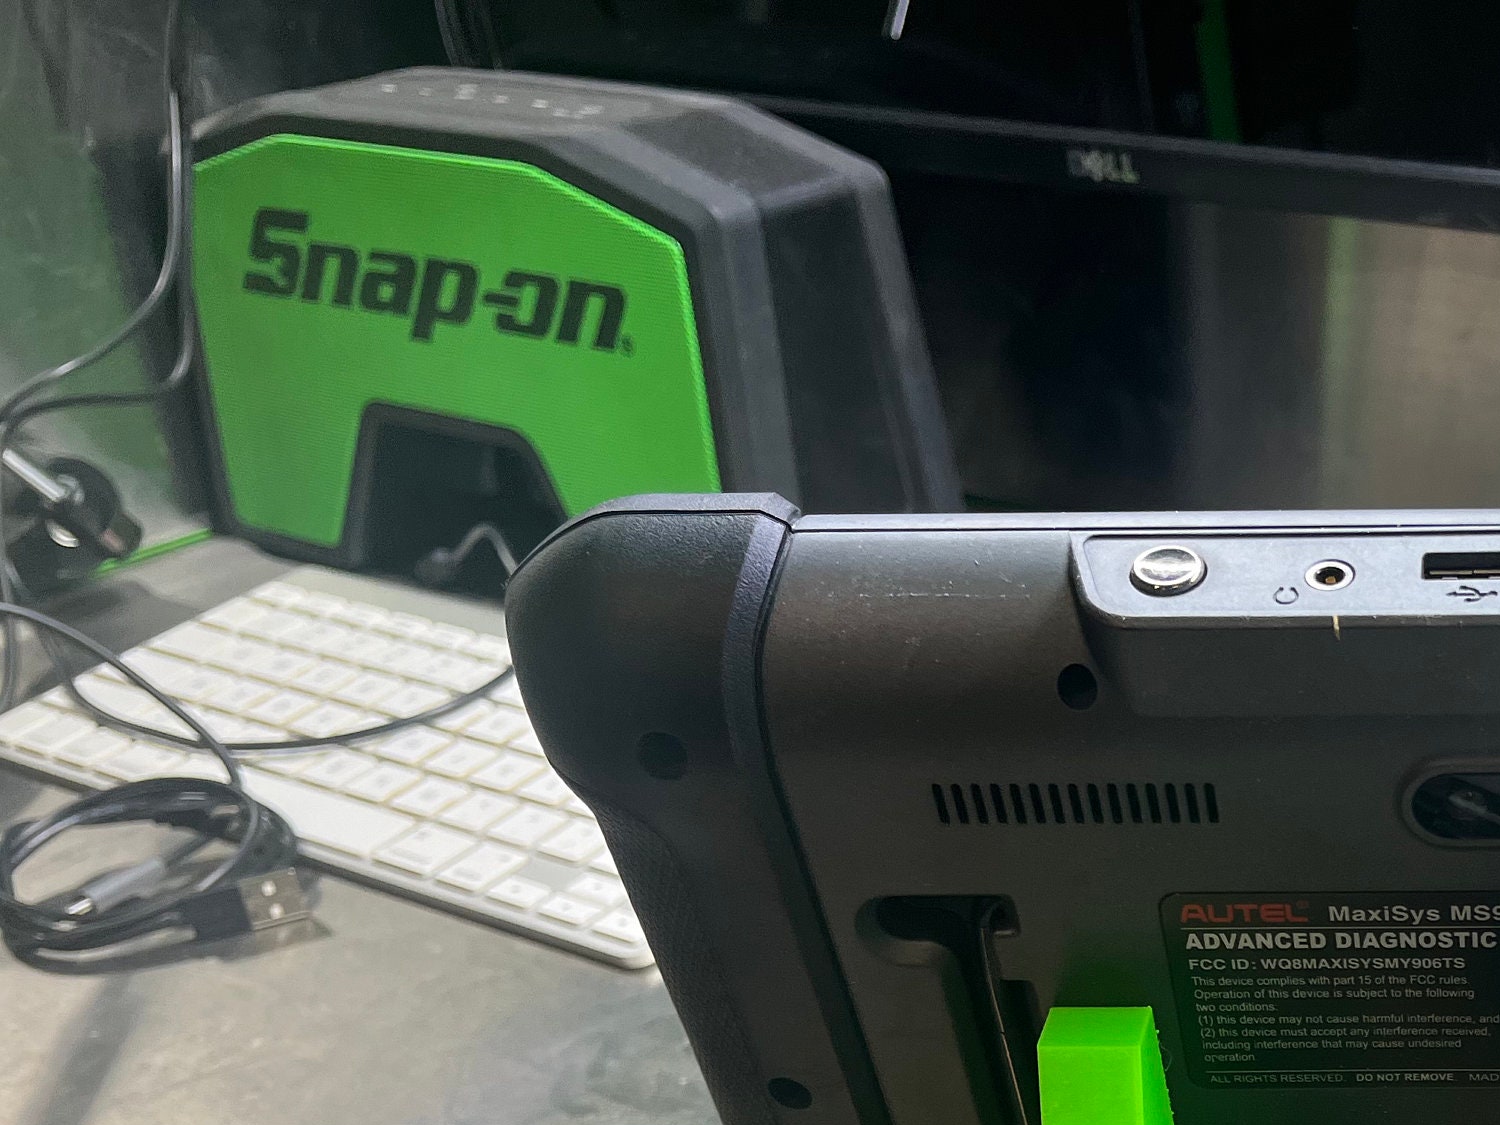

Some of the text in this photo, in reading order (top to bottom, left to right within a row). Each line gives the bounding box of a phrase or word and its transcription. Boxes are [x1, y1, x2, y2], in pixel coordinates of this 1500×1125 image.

[243, 206, 628, 351] Snap-on
[1327, 904, 1441, 926] MaxiSys
[1185, 931, 1327, 950] ADVANCED
[1334, 931, 1498, 949] DIAGNOSTIC
[1188, 958, 1467, 970] FCC ID: WQ8MAXISYSMY906TS
[1191, 976, 1216, 986] This
[1218, 976, 1254, 986] device
[1256, 976, 1307, 988] complies
[1309, 976, 1331, 986] with
[1333, 976, 1355, 988] part
[1359, 975, 1372, 985] 15
[1374, 975, 1386, 985] of
[1388, 975, 1406, 985] the
[1409, 975, 1436, 985] FCC
[1194, 988, 1475, 1001] Operation of this device is subject to the following
[1195, 1002, 1216, 1012] two
[1198, 1015, 1213, 1027] (1)
[1216, 1015, 1237, 1025] this
[1239, 1015, 1276, 1025] device
[1278, 1016, 1303, 1026] may
[1305, 1015, 1324, 1024] not
[1326, 1015, 1360, 1024] cause
[1362, 1013, 1404, 1024] harmful
[1479, 1013, 1500, 1024] and
[1200, 1027, 1216, 1039] (2)
[1218, 1027, 1239, 1037] this
[1241, 1028, 1277, 1037] device
[1280, 1027, 1309, 1037] must
[1310, 1027, 1348, 1038] accept
[1349, 1028, 1370, 1038] any
[1372, 1026, 1438, 1037] interference
[1202, 1037, 1462, 1051] including interference that may cause undesired
[1210, 1074, 1231, 1084] ALL
[1233, 1074, 1277, 1083] RIGHTS
[1356, 1073, 1374, 1082] DO
[1376, 1073, 1401, 1082] NOT
